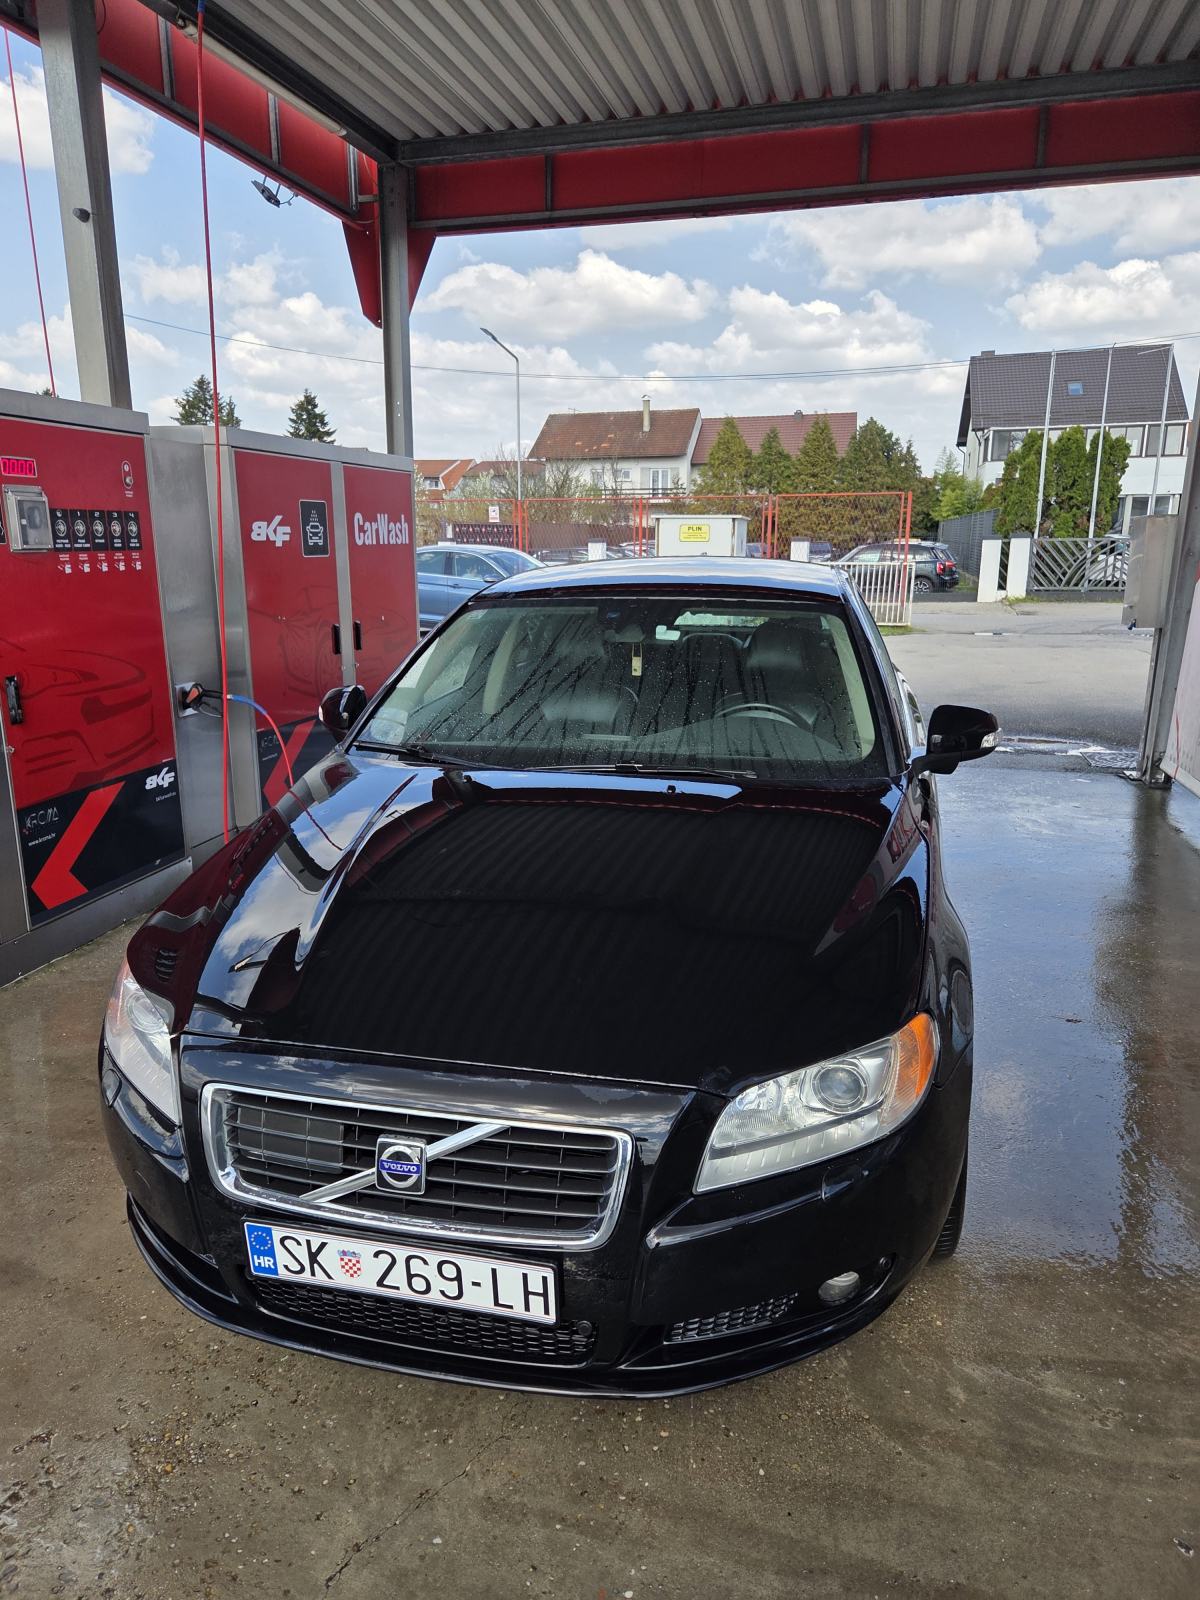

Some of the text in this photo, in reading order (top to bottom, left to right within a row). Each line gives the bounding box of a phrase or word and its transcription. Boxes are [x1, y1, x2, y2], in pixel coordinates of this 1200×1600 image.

[251, 515, 292, 547] BKF
[353, 512, 409, 546] CarWash
[145, 767, 176, 790] BKF
[28, 832, 57, 847] www.kroma.hr
[382, 1161, 418, 1173] VOLVO
[254, 1254, 275, 1270] HR
[279, 1235, 550, 1317] SK 269-LH
